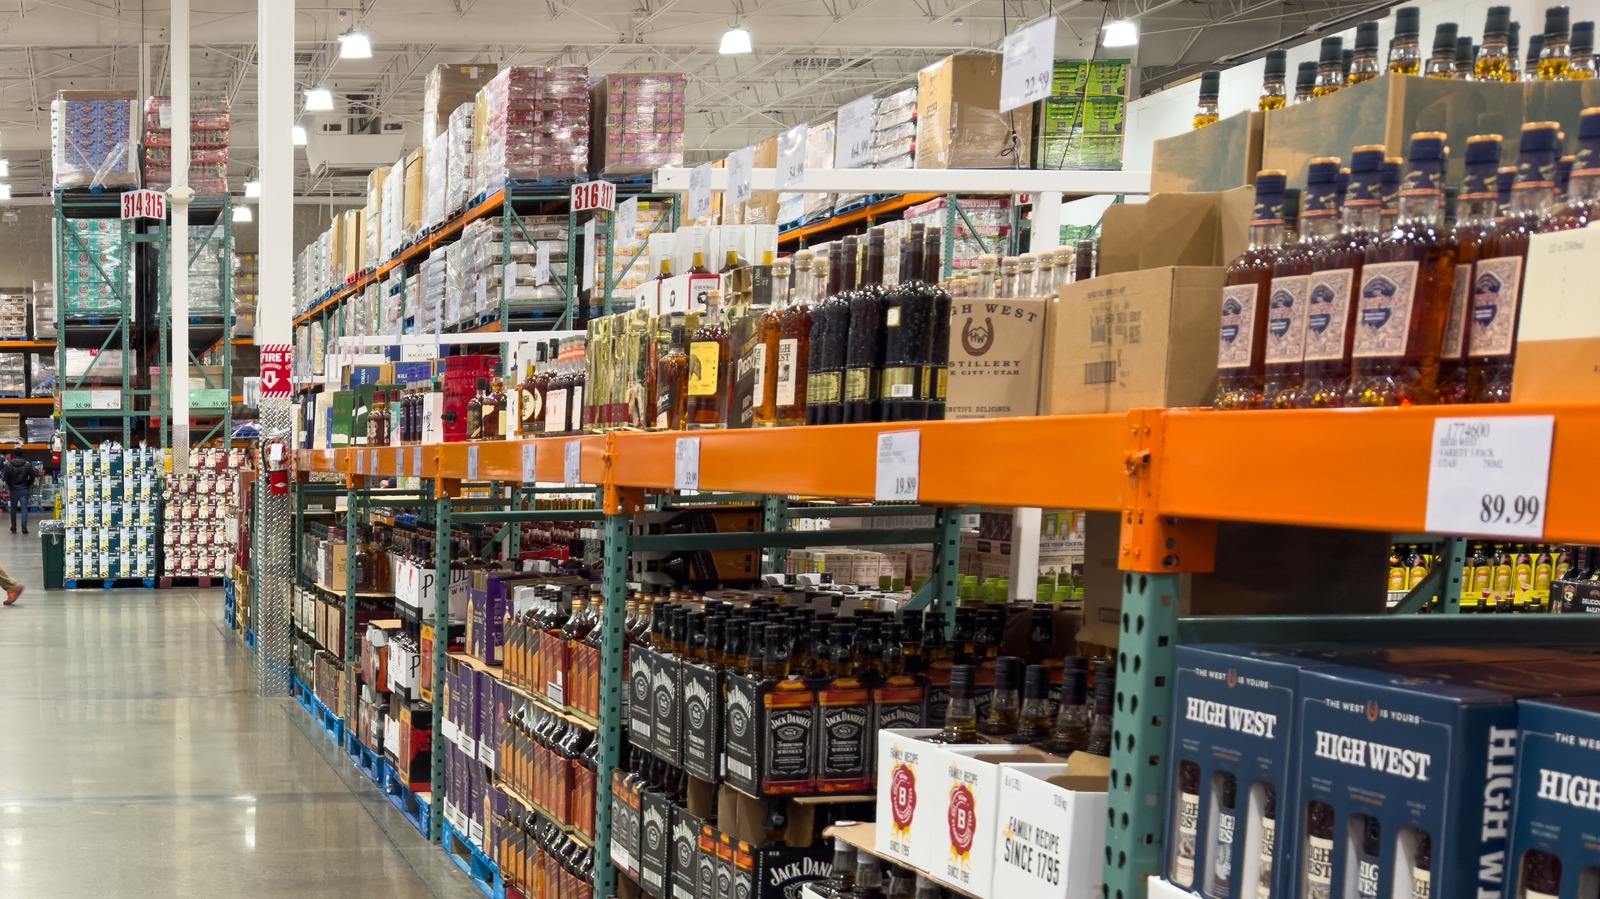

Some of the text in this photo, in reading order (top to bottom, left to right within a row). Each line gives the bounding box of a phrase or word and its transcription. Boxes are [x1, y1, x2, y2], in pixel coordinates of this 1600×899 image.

[1024, 70, 1049, 98] 22.99
[851, 138, 869, 160] 64.99
[124, 192, 163, 219] 314 315
[574, 183, 613, 210] 316 317
[985, 303, 1038, 323] WEST
[262, 352, 283, 363] FIRE
[949, 360, 1021, 368] STILLERY
[1480, 493, 1540, 525] 89.99
[1194, 667, 1208, 677] THE
[1208, 671, 1227, 681] WEST
[1246, 677, 1270, 689] YOURS
[771, 713, 812, 730] JACK DANIEL'S
[825, 711, 866, 727] JACK DANIEL'S
[880, 711, 897, 725] JACK
[1185, 696, 1278, 739] HIGH WEST
[1325, 698, 1341, 709] THE
[1342, 702, 1365, 714] WEST
[1390, 711, 1421, 725] YOURS
[1554, 732, 1576, 745] THE
[1314, 730, 1431, 781] HIGH WEST
[898, 786, 907, 806] B
[1481, 725, 1518, 844] HIGH
[957, 808, 967, 829] B
[1009, 816, 1060, 855] FAMILY RECIPE
[770, 861, 802, 887] JACK
[802, 856, 833, 878] DANI
[1004, 838, 1060, 886] SINCE 1795
